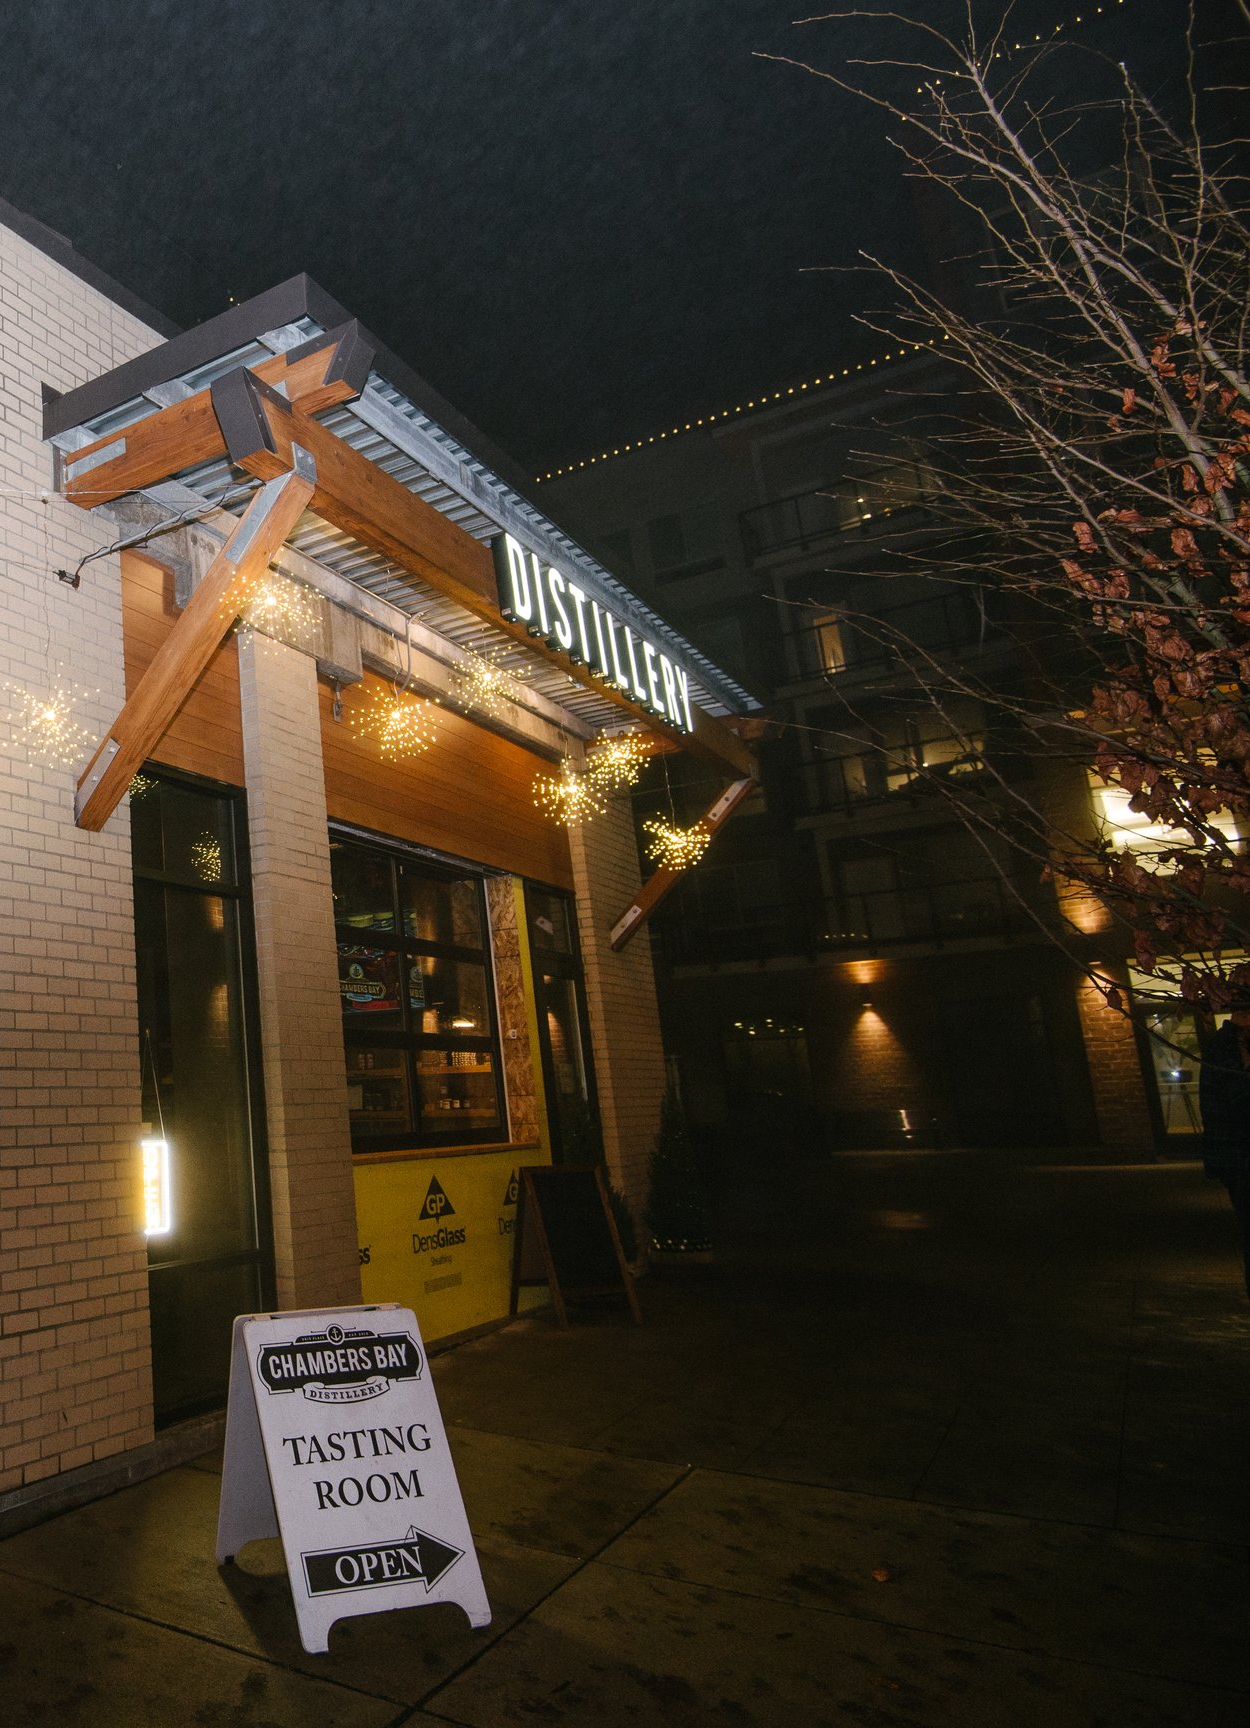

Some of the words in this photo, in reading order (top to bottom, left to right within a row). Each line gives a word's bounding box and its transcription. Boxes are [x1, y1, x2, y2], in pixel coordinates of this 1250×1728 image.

[504, 532, 693, 733] DISTILLERY
[426, 1193, 445, 1215] GP
[412, 1226, 467, 1254] DensGlass
[268, 1346, 372, 1379] CHAMBERS
[373, 1343, 408, 1369] BAY
[309, 1382, 384, 1400] DISTILLERY
[282, 1423, 432, 1467] TASTING
[312, 1469, 425, 1511] ROOM
[334, 1546, 423, 1586] OPEN
